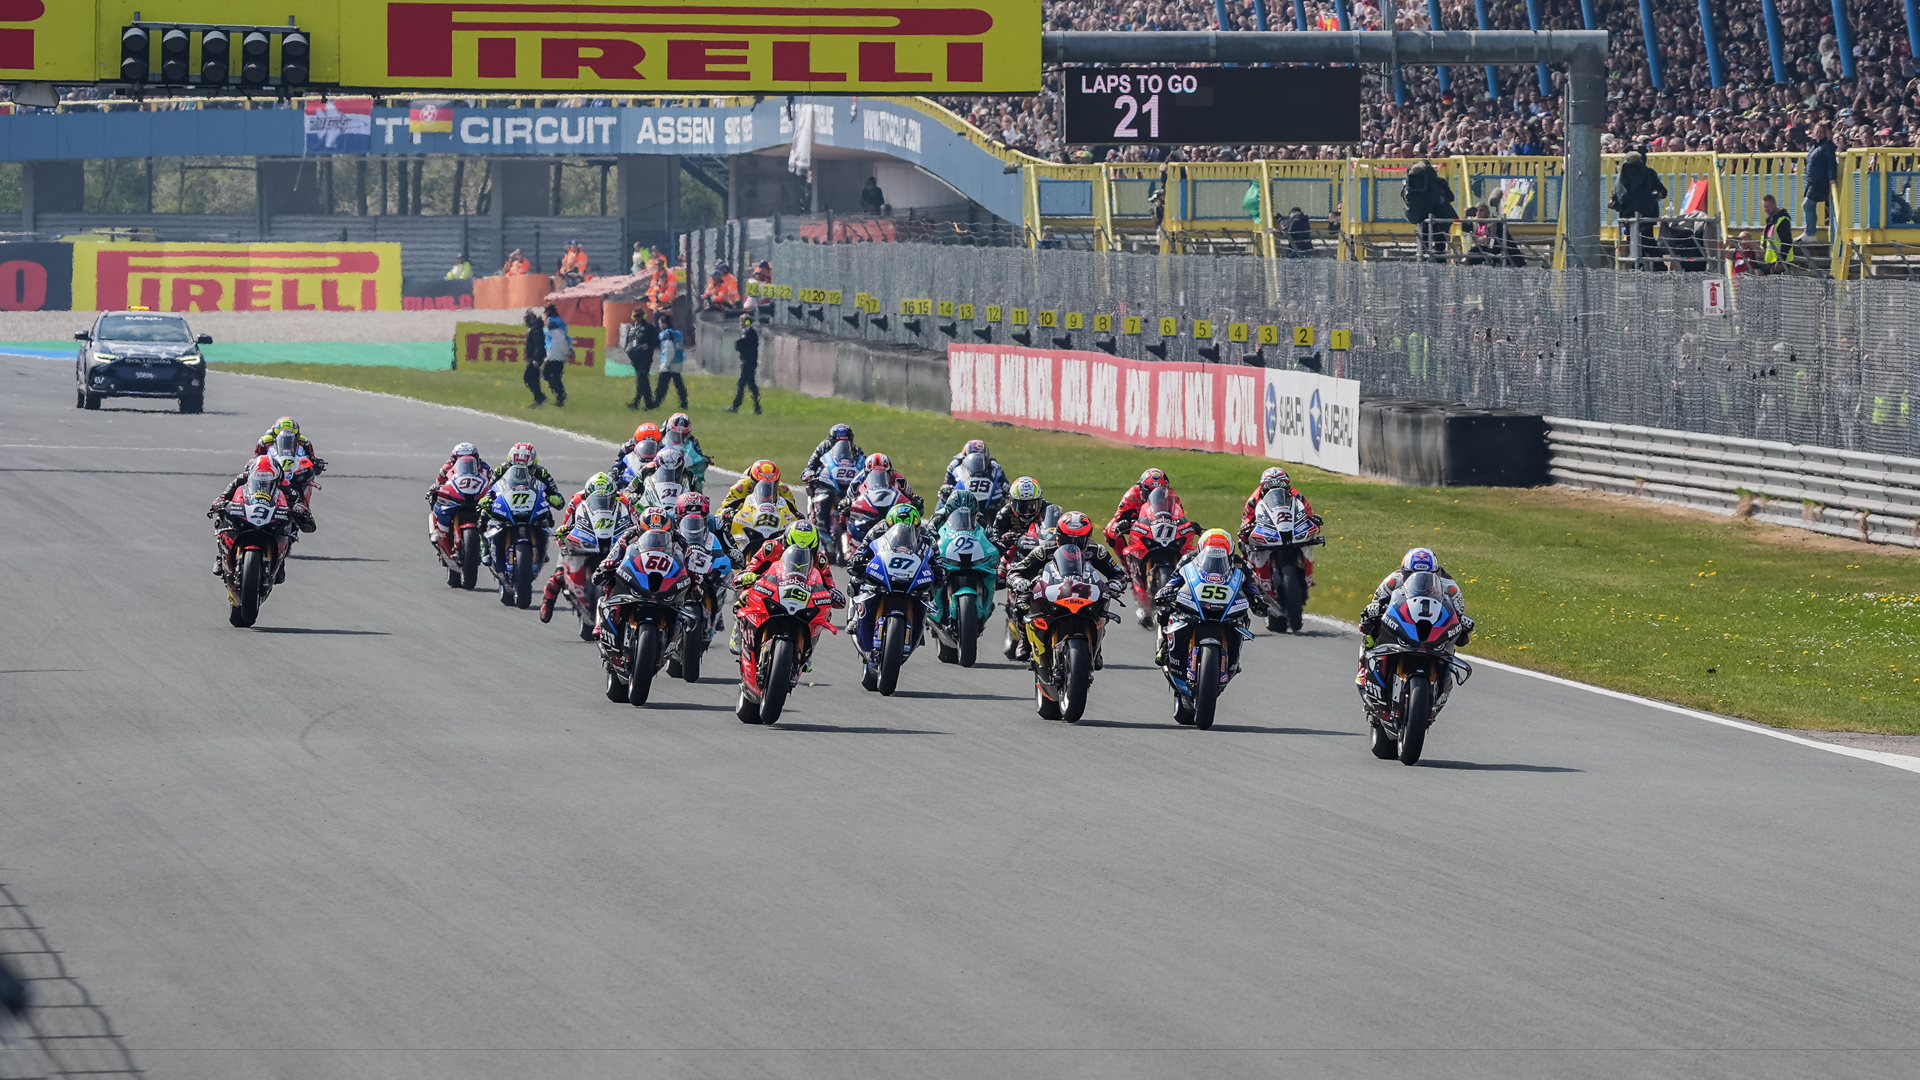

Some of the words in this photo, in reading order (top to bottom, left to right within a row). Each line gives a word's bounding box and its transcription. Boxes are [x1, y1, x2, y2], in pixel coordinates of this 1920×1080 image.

[387, 3, 993, 82] PIRELLI
[1081, 75, 1131, 94] LAPS
[1136, 75, 1163, 94] TO
[1167, 74, 1198, 94] GO
[1113, 95, 1159, 138] 21
[460, 116, 617, 145] CIRCUIT
[637, 116, 715, 145] ASSEN
[96, 249, 380, 311] PIRELLI
[812, 290, 826, 302] 20
[866, 300, 878, 313] 17
[904, 301, 915, 314] 16
[918, 301, 929, 314] 15
[940, 303, 952, 314] 14
[960, 306, 972, 318] 13
[988, 308, 1000, 321] 12
[1014, 310, 1026, 324] 11
[1040, 312, 1053, 326] 10
[1070, 315, 1077, 328] 9
[1099, 316, 1108, 331] 8
[1130, 320, 1136, 334] 7
[1164, 320, 1172, 334] 6
[1199, 322, 1206, 336] 5
[1234, 326, 1242, 340] 4
[1264, 328, 1274, 342] 3
[1300, 330, 1308, 344] 2
[1338, 333, 1342, 348] 1
[1225, 374, 1258, 447] OIL
[1324, 402, 1354, 448] SUBARU
[459, 478, 482, 490] 97
[970, 480, 990, 493] 99
[512, 493, 530, 505] 77
[662, 488, 678, 499] 31
[874, 490, 890, 503] 7
[250, 506, 270, 520] 9
[1276, 512, 1292, 524] 22
[756, 514, 780, 528] 29
[1156, 524, 1174, 539] 11
[954, 536, 975, 552] 95
[644, 555, 672, 572] 60
[888, 556, 914, 570] 87
[754, 584, 772, 596] Lenovo
[780, 588, 810, 603] 19
[1201, 585, 1228, 600] 55
[1418, 600, 1433, 617] 1
